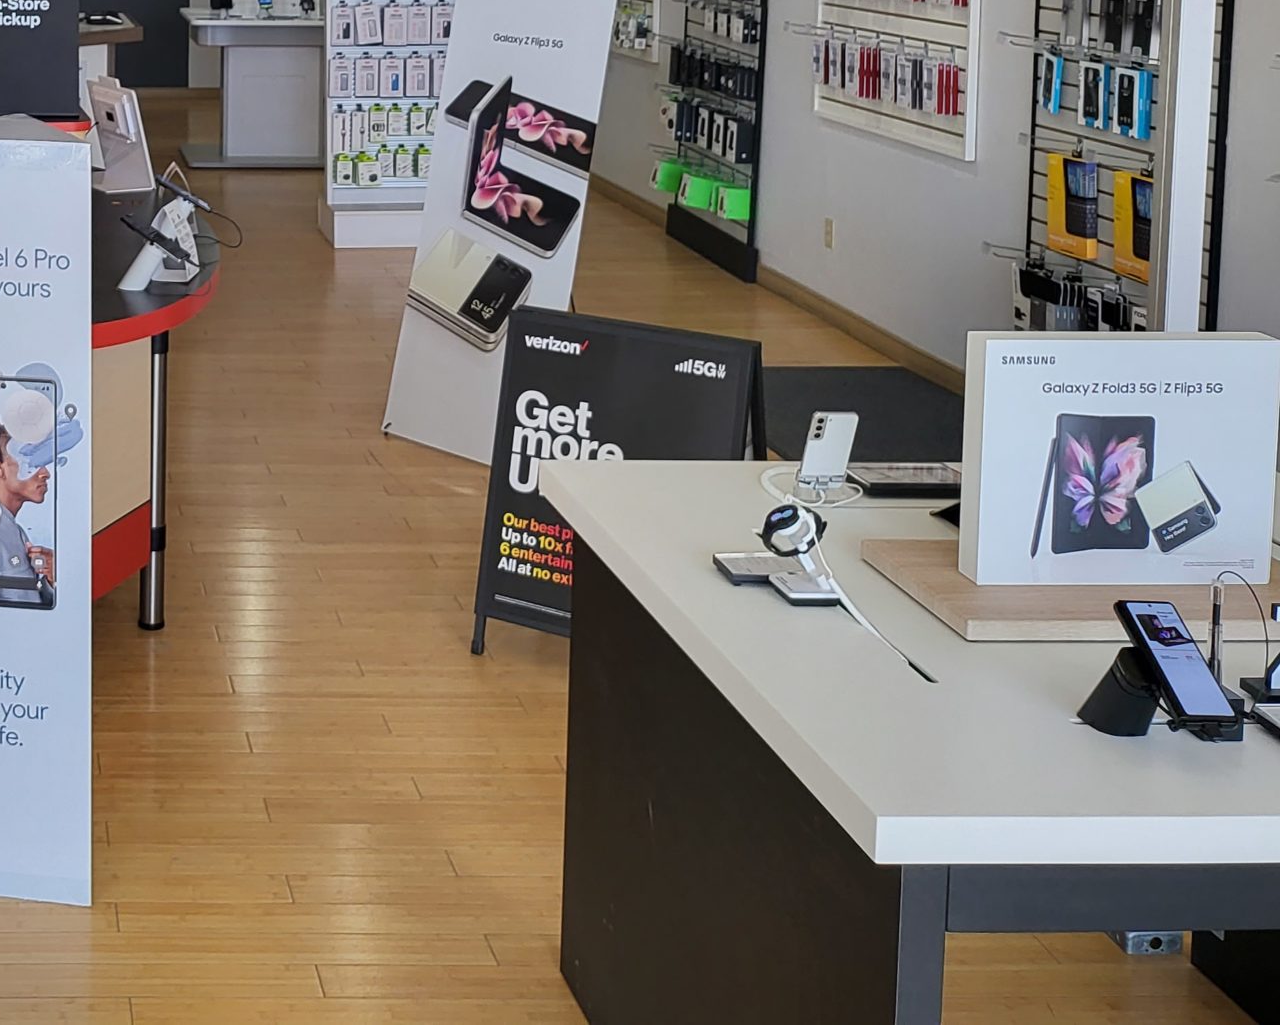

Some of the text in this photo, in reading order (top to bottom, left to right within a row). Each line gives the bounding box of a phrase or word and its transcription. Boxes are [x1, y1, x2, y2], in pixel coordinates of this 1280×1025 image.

[493, 33, 564, 48] Galaxy Z Flip3 5G
[15, 248, 28, 268] 6
[34, 248, 70, 270] Pro
[471, 299, 484, 311] 12
[481, 305, 495, 319] 45
[524, 335, 581, 355] verizon
[692, 360, 717, 378] 5G
[1001, 356, 1056, 365] SAMSUNG
[1042, 382, 1224, 397] Galaxy Z Fold3 5G Z Flip3 5G
[515, 389, 592, 438] Get
[511, 426, 624, 461] more
[503, 512, 529, 528] Our
[530, 517, 560, 537] best
[501, 526, 521, 544] Up
[522, 531, 537, 546] to
[538, 536, 563, 552] 10x
[500, 541, 573, 570] 6 entertain
[498, 556, 517, 572] All
[517, 563, 532, 576] at
[532, 567, 551, 580] no
[0, 702, 49, 723] your
